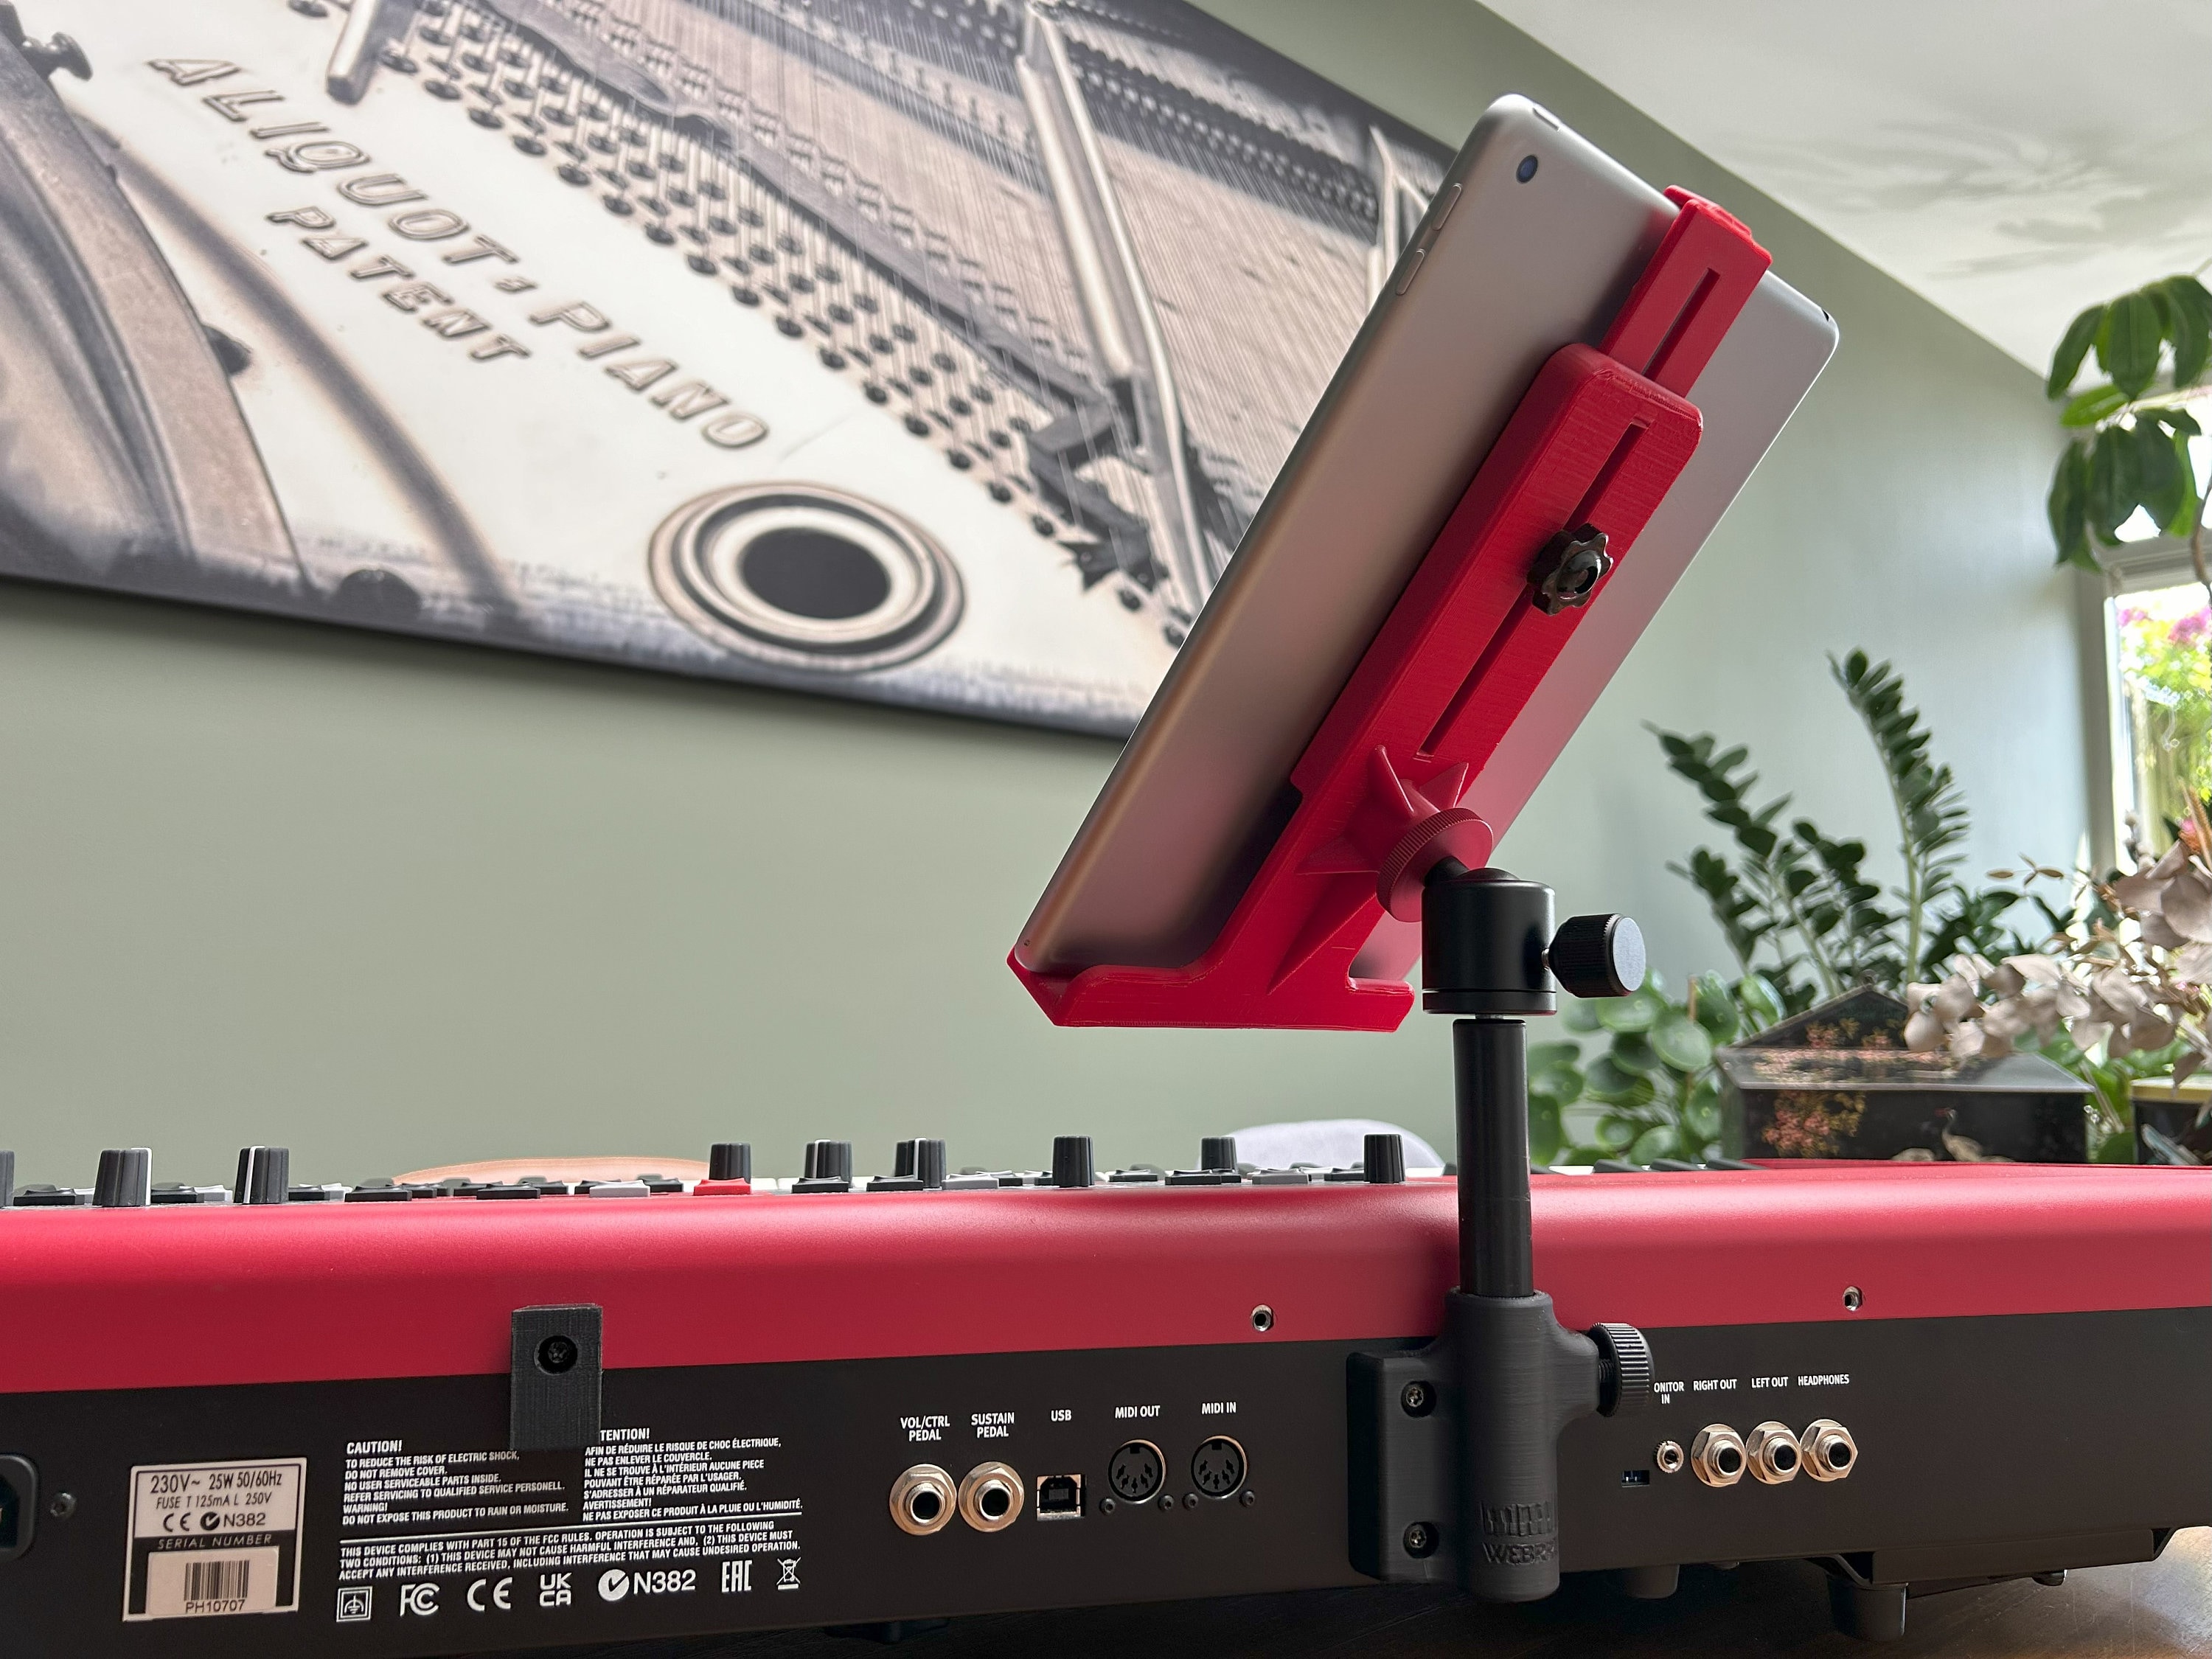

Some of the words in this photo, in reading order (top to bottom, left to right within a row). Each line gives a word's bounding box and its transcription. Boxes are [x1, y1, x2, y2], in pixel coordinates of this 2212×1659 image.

[266, 206, 531, 362] PATENT
[529, 301, 769, 449] PIANO
[1654, 1381, 1684, 1393] ONITOR
[1693, 1380, 1719, 1391] RIGHT
[1719, 1379, 1737, 1390] OUT
[1751, 1377, 1770, 1388] LEFT
[1771, 1376, 1789, 1388] OUT
[1798, 1374, 1850, 1386] HEADPHONES
[1661, 1394, 1671, 1404] IN
[1115, 1406, 1137, 1419] MIDI
[1138, 1405, 1161, 1418] OUT
[1201, 1402, 1223, 1415] MIDI
[1225, 1401, 1237, 1413] IN
[900, 1416, 950, 1429] VOL/CTRL
[971, 1412, 1015, 1426] SUSTAIN
[1051, 1410, 1072, 1422] USB
[600, 1427, 650, 1441] TENTION!
[908, 1428, 942, 1441] PEDAL
[976, 1425, 1009, 1438] PEDAL
[347, 1439, 402, 1454] CAUTION!
[585, 1445, 604, 1455] AFIN
[605, 1445, 616, 1455] DE
[618, 1441, 653, 1454] RÉDUIRE
[655, 1443, 664, 1453] LE
[666, 1441, 695, 1452] RISQUE
[697, 1441, 707, 1450] DE
[709, 1440, 731, 1450] CHOC
[732, 1436, 781, 1450] ÉLECTRIQUE,
[346, 1458, 358, 1469] TO
[359, 1457, 393, 1468] REDUCE
[395, 1456, 411, 1467] THE
[413, 1455, 434, 1465] RISK
[435, 1454, 446, 1464] OF
[448, 1452, 487, 1464] ELECTRIC
[585, 1457, 596, 1467] NE
[597, 1456, 613, 1466] PAS
[615, 1454, 650, 1465] ENLEVER
[653, 1453, 662, 1464] LE
[664, 1451, 712, 1463] COUVERCLE.
[345, 1470, 358, 1480] DO
[360, 1468, 378, 1479] NOT
[379, 1467, 415, 1478] REMOVE
[584, 1468, 593, 1478] IL
[594, 1467, 605, 1477] NE
[606, 1467, 617, 1477] SE
[618, 1465, 651, 1476] TROUVE
[652, 1463, 658, 1474] À
[659, 1460, 708, 1474] L'INTÉRIEUR
[709, 1461, 741, 1472] AUCUNE
[742, 1459, 765, 1470] PIECE
[209, 1473, 233, 1489] 25W
[237, 1471, 282, 1489] 50/60Hz
[344, 1481, 358, 1491] NO
[359, 1479, 383, 1490] USER
[384, 1476, 440, 1489] SERVICEABLE
[442, 1475, 470, 1486] PARTS
[471, 1473, 501, 1484] INSIDE.
[584, 1477, 622, 1489] POUVANT
[624, 1474, 644, 1486] ÊTRE
[645, 1472, 681, 1486] RÉPARÉE
[682, 1473, 699, 1484] PAR
[344, 1492, 372, 1503] REFER
[373, 1489, 419, 1501] SERVICING
[420, 1488, 432, 1498] TO
[434, 1486, 477, 1498] QUALIFIED
[479, 1484, 513, 1495] SERVICE
[584, 1488, 633, 1500] S'ADRESSER
[635, 1485, 641, 1497] À
[643, 1486, 655, 1496] UN
[656, 1482, 708, 1495] RÉPARATEUR
[709, 1480, 747, 1492] QUALIFIÉ.
[156, 1496, 181, 1509] FUSE
[187, 1495, 192, 1508] T
[195, 1495, 230, 1508] 125mA
[246, 1492, 272, 1505] 250V
[344, 1502, 388, 1514] WARNING!
[583, 1498, 651, 1510] AVERTISSEMENT!
[342, 1514, 355, 1526] DO
[357, 1514, 375, 1525] NOT
[377, 1512, 409, 1523] EXPOSE
[411, 1510, 431, 1521] THIS
[433, 1508, 473, 1520] PRODUCT
[475, 1507, 485, 1517] TO
[487, 1506, 507, 1516] RAIN
[509, 1505, 521, 1515] OR
[524, 1502, 568, 1514] MOISTURE.
[582, 1512, 594, 1522] NE
[595, 1511, 611, 1521] PAS
[613, 1509, 650, 1520] EXPOSER
[652, 1508, 661, 1518] CE
[664, 1506, 698, 1517] PRODUIT
[700, 1503, 706, 1515] À
[707, 1505, 717, 1514] LA
[719, 1503, 741, 1514] PLUIE
[743, 1503, 754, 1513] OU
[756, 1498, 802, 1512] L'HUMIDITÉ.
[223, 1512, 266, 1527] N382
[158, 1537, 206, 1548] SERIAL
[212, 1534, 272, 1546] NUMBER
[341, 1546, 361, 1557] THIS
[364, 1544, 396, 1556] DEVICE
[398, 1541, 444, 1554] COMPLIES
[446, 1540, 469, 1551] WITH
[472, 1538, 494, 1549] PART
[498, 1537, 507, 1548] 15
[510, 1537, 521, 1546] OF
[524, 1535, 540, 1545] THE
[543, 1534, 559, 1545] FCC
[561, 1532, 592, 1543] RULES.
[595, 1529, 643, 1541] OPERATION
[645, 1528, 654, 1538] IS
[656, 1526, 692, 1537] SUBJECT
[695, 1525, 706, 1535] TO
[708, 1524, 723, 1534] THE
[726, 1521, 774, 1533] FOLLOWING
[339, 1558, 361, 1569] TWO
[363, 1554, 421, 1568] CONDITIONS:
[426, 1553, 439, 1563] (1)
[440, 1551, 462, 1562] THIS
[464, 1549, 495, 1561] DEVICE
[497, 1548, 516, 1559] MAY
[519, 1547, 536, 1557] NOT
[539, 1545, 568, 1556] CAUSE
[569, 1542, 611, 1554] HARMFUL
[613, 1537, 675, 1551] INTERFERENCE
[703, 1535, 714, 1545] (2)
[716, 1534, 736, 1545] THIS
[737, 1531, 767, 1543] DEVICE
[768, 1530, 792, 1541] MUST
[339, 1568, 374, 1580] ACCEPT
[376, 1568, 394, 1578] ANY
[397, 1563, 462, 1576] INTERFERENCE
[513, 1557, 560, 1568] INCLUDING
[563, 1552, 626, 1565] INTERFERENCE
[628, 1551, 650, 1561] THAT
[652, 1549, 670, 1559] MAY
[672, 1547, 700, 1558] CAUSE
[703, 1544, 749, 1557] UNDESIRED
[751, 1541, 800, 1553] OPERATION.
[540, 1572, 572, 1590] UK
[634, 1570, 696, 1595] N382
[185, 1599, 246, 1613] PH10707
[540, 1590, 572, 1607] CA
